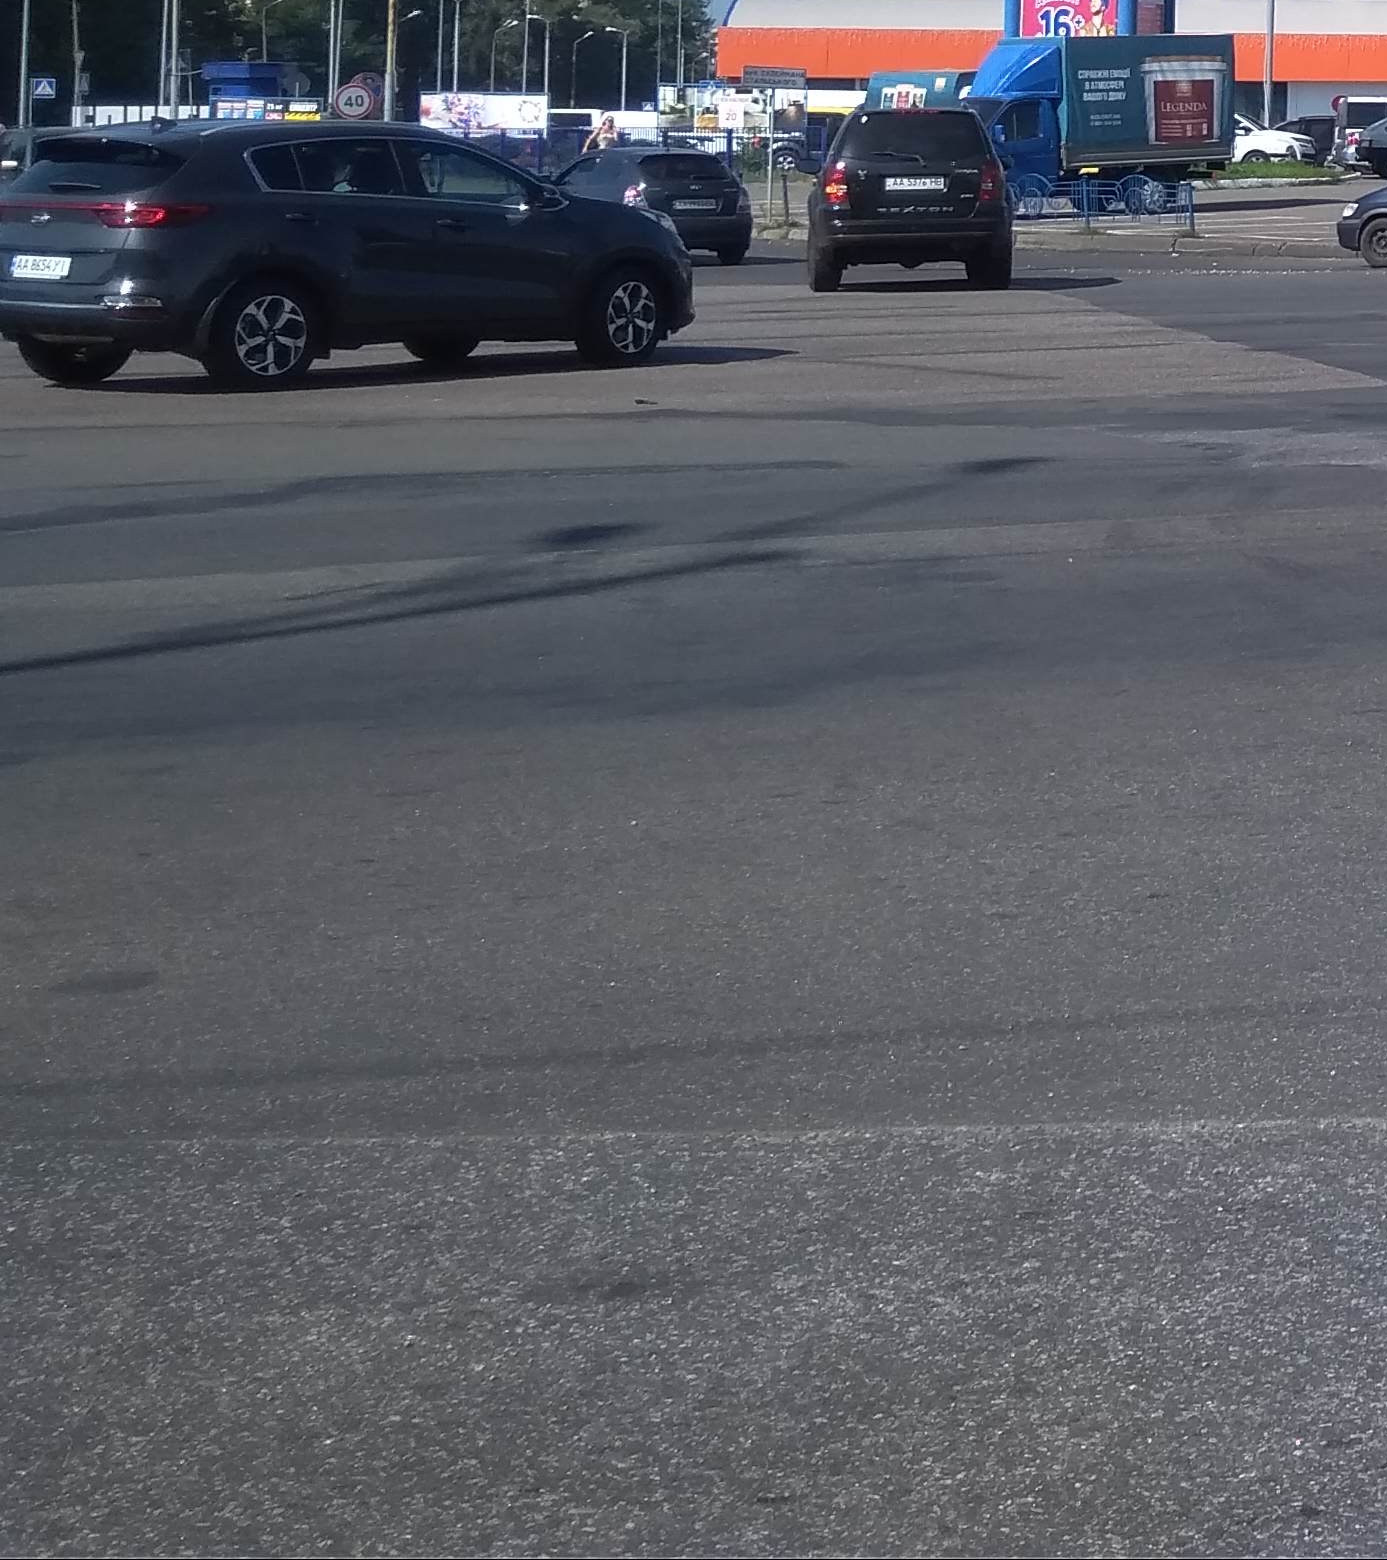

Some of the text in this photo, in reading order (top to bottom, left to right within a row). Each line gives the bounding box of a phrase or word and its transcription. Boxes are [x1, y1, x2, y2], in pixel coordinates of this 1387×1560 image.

[343, 94, 364, 108] 40
[1160, 101, 1208, 112] LEGENDA
[725, 112, 737, 121] 20
